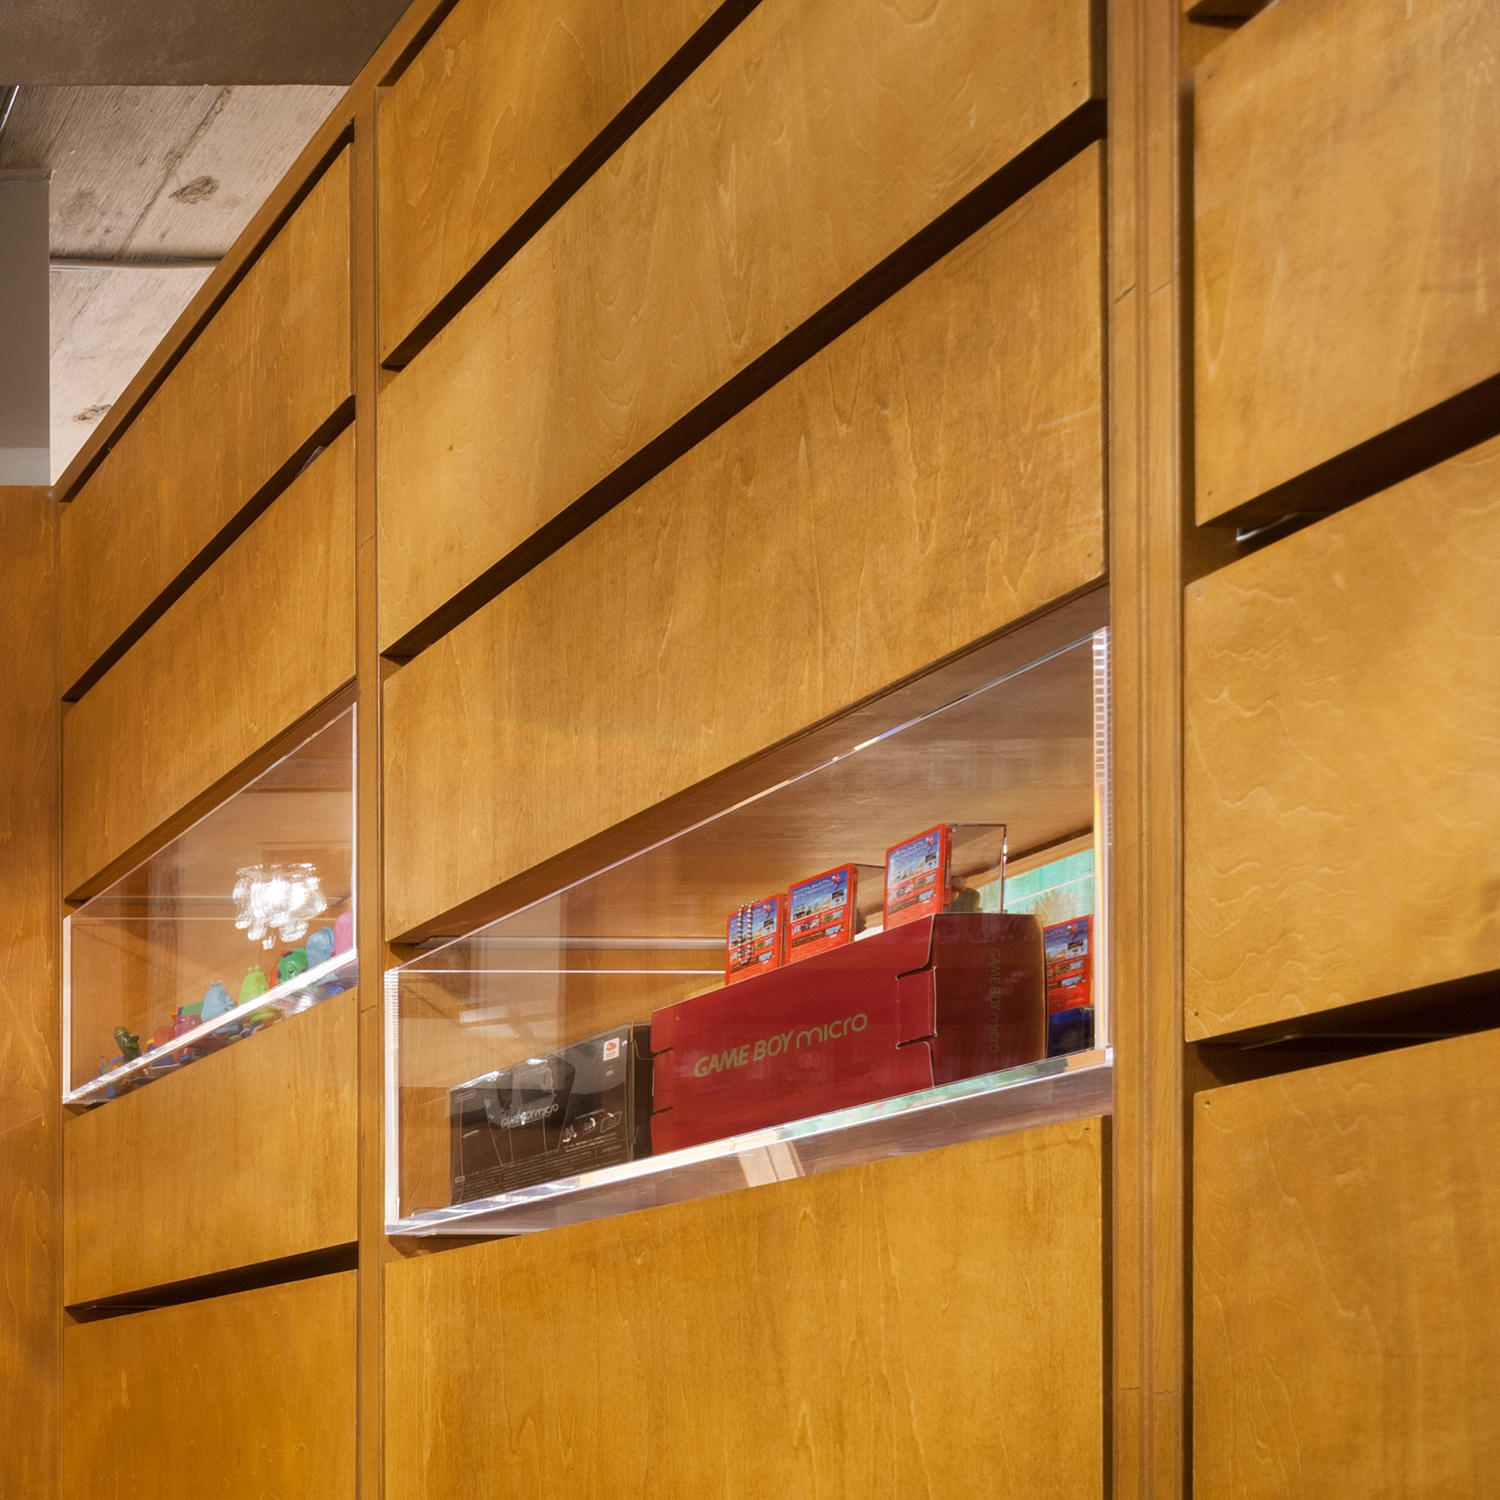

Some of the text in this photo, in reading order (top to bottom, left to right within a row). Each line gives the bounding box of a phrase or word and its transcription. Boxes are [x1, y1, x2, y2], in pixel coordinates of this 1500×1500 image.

[989, 948, 1001, 1054] GAME BOY micro
[694, 1013, 868, 1078] GAME BOY micro
